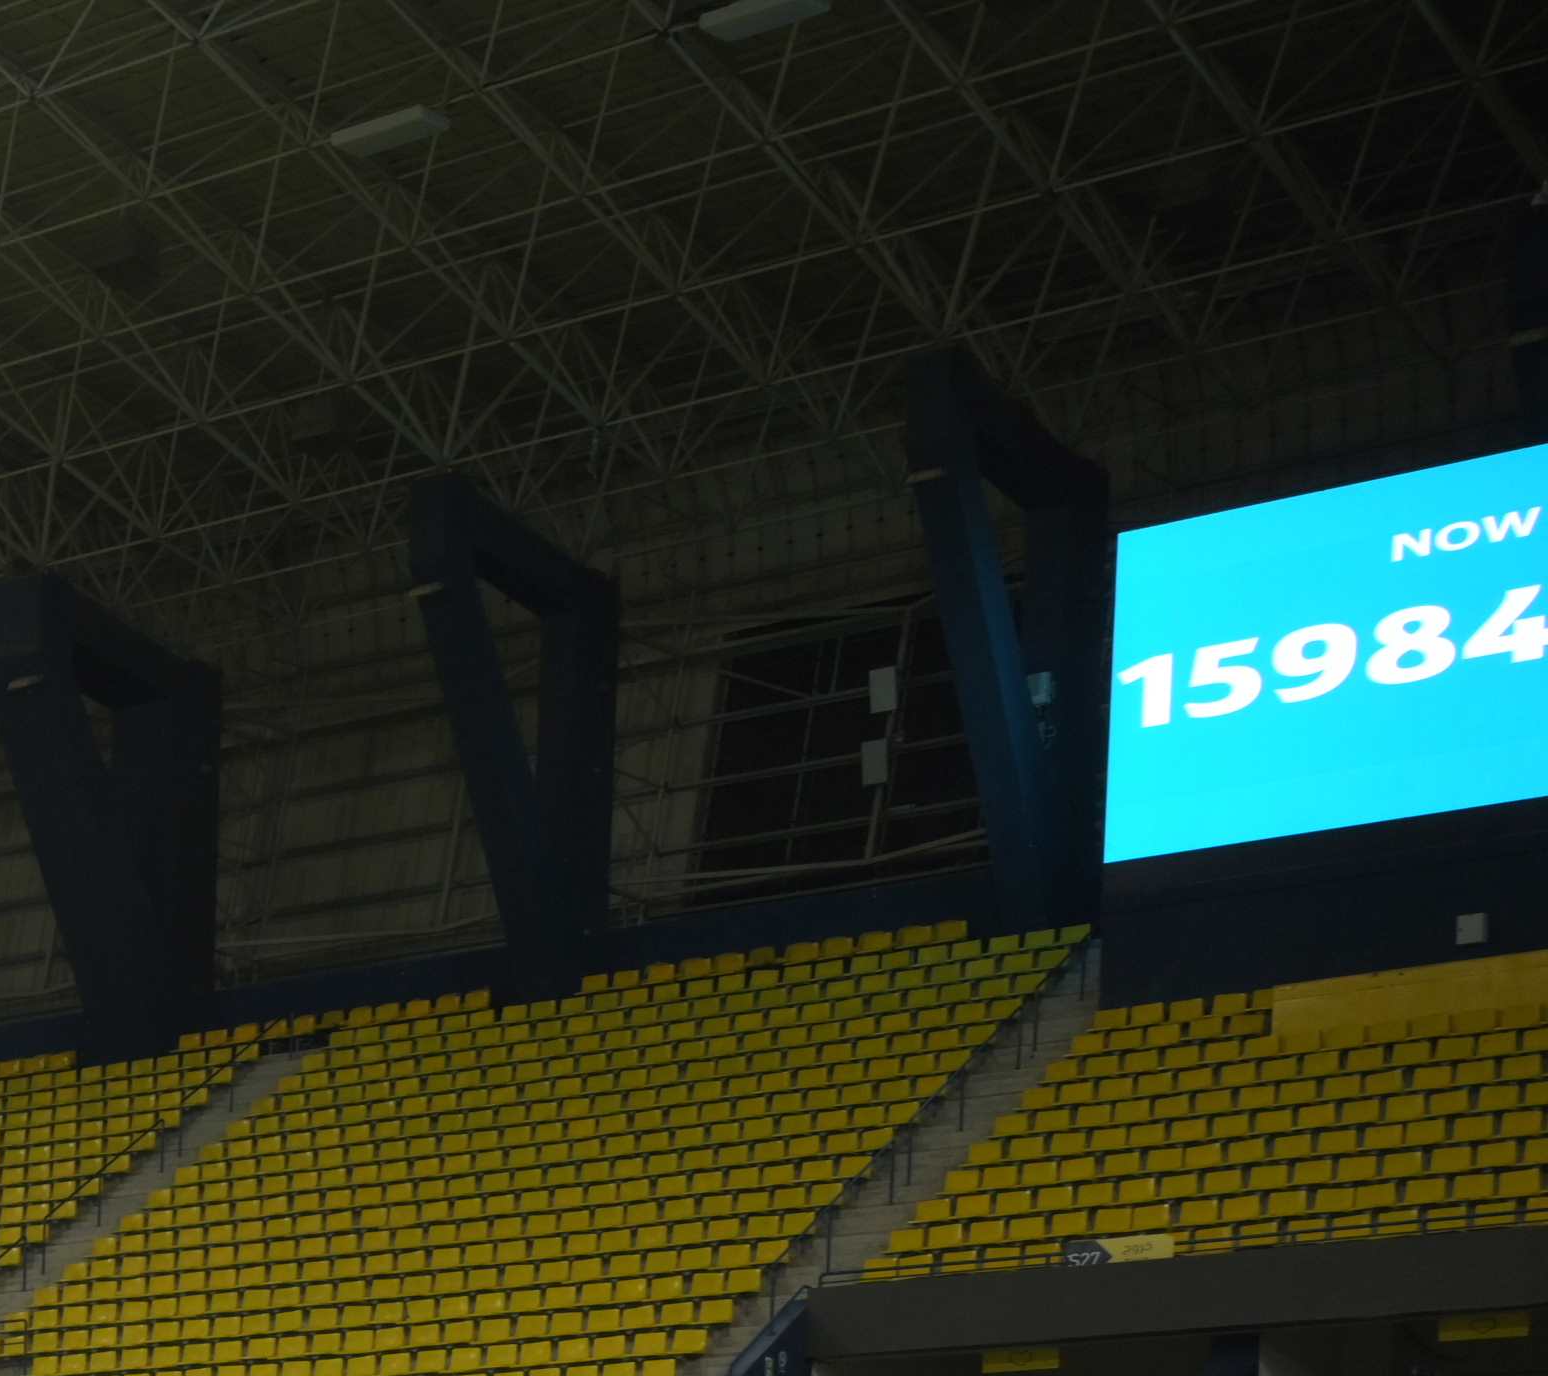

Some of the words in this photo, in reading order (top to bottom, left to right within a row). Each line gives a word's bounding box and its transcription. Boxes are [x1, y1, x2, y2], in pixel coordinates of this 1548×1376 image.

[1390, 506, 1542, 563] NOW
[1117, 584, 1548, 729] 15984
[1067, 1251, 1101, 1267] S27
